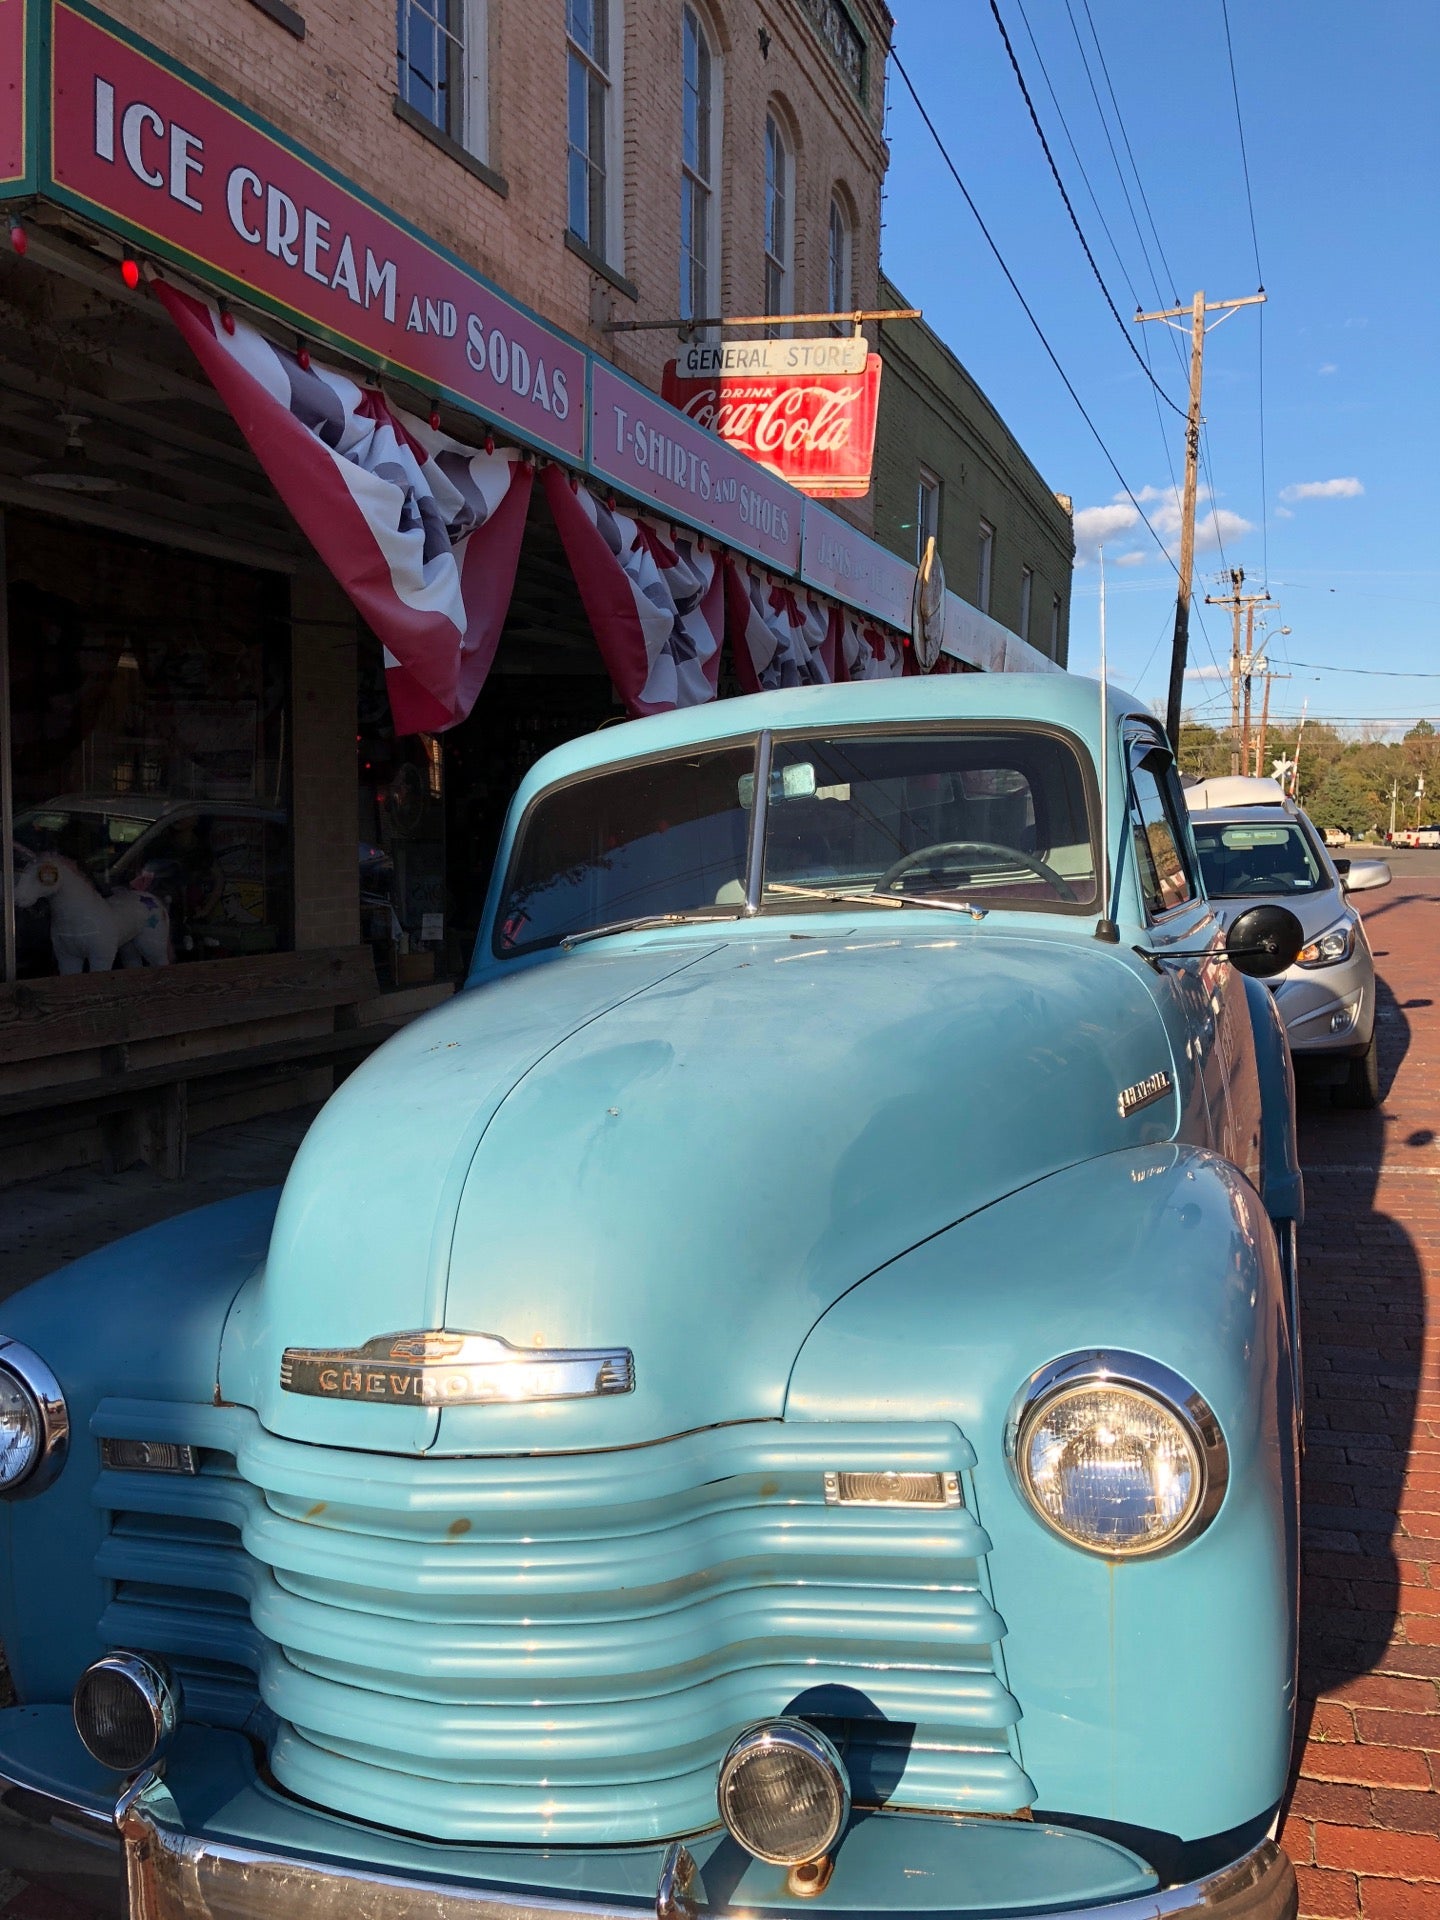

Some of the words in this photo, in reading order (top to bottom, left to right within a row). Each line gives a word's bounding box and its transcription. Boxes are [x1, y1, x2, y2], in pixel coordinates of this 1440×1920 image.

[94, 76, 204, 214] ICE
[226, 166, 397, 325] CREAM
[405, 295, 458, 338] AND
[465, 312, 570, 421] SODAS
[687, 349, 773, 371] GENERAL
[787, 345, 855, 367] STORE
[720, 387, 778, 399] DRINK
[680, 386, 865, 452] Coca-Cola
[613, 405, 712, 501] T-SHIRTS
[714, 477, 737, 503] AND
[739, 484, 789, 544] SHOES
[319, 1369, 556, 1397] CHEVROLT
